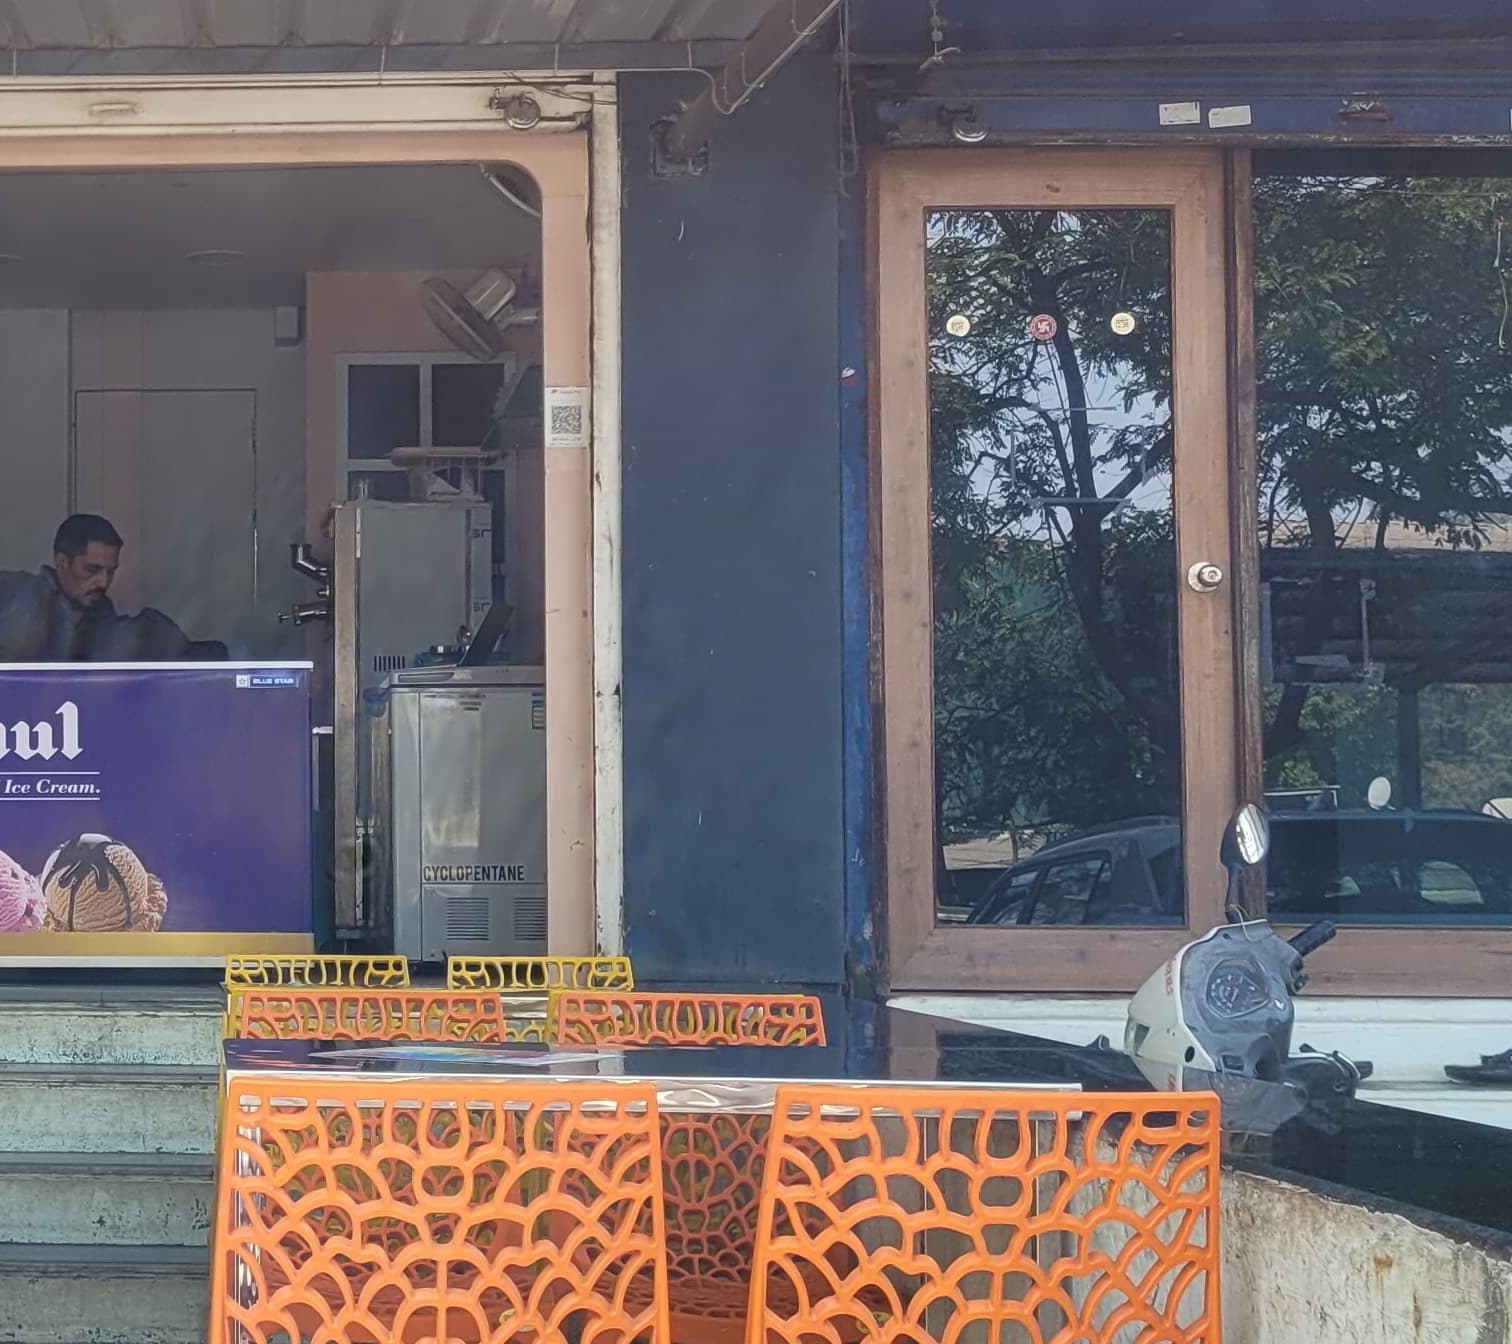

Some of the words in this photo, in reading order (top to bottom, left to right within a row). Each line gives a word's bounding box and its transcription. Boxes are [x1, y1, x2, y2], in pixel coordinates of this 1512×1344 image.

[4, 779, 31, 794] Ice
[36, 778, 101, 794] Cream.
[423, 865, 525, 881] CYCLOPENTANE
